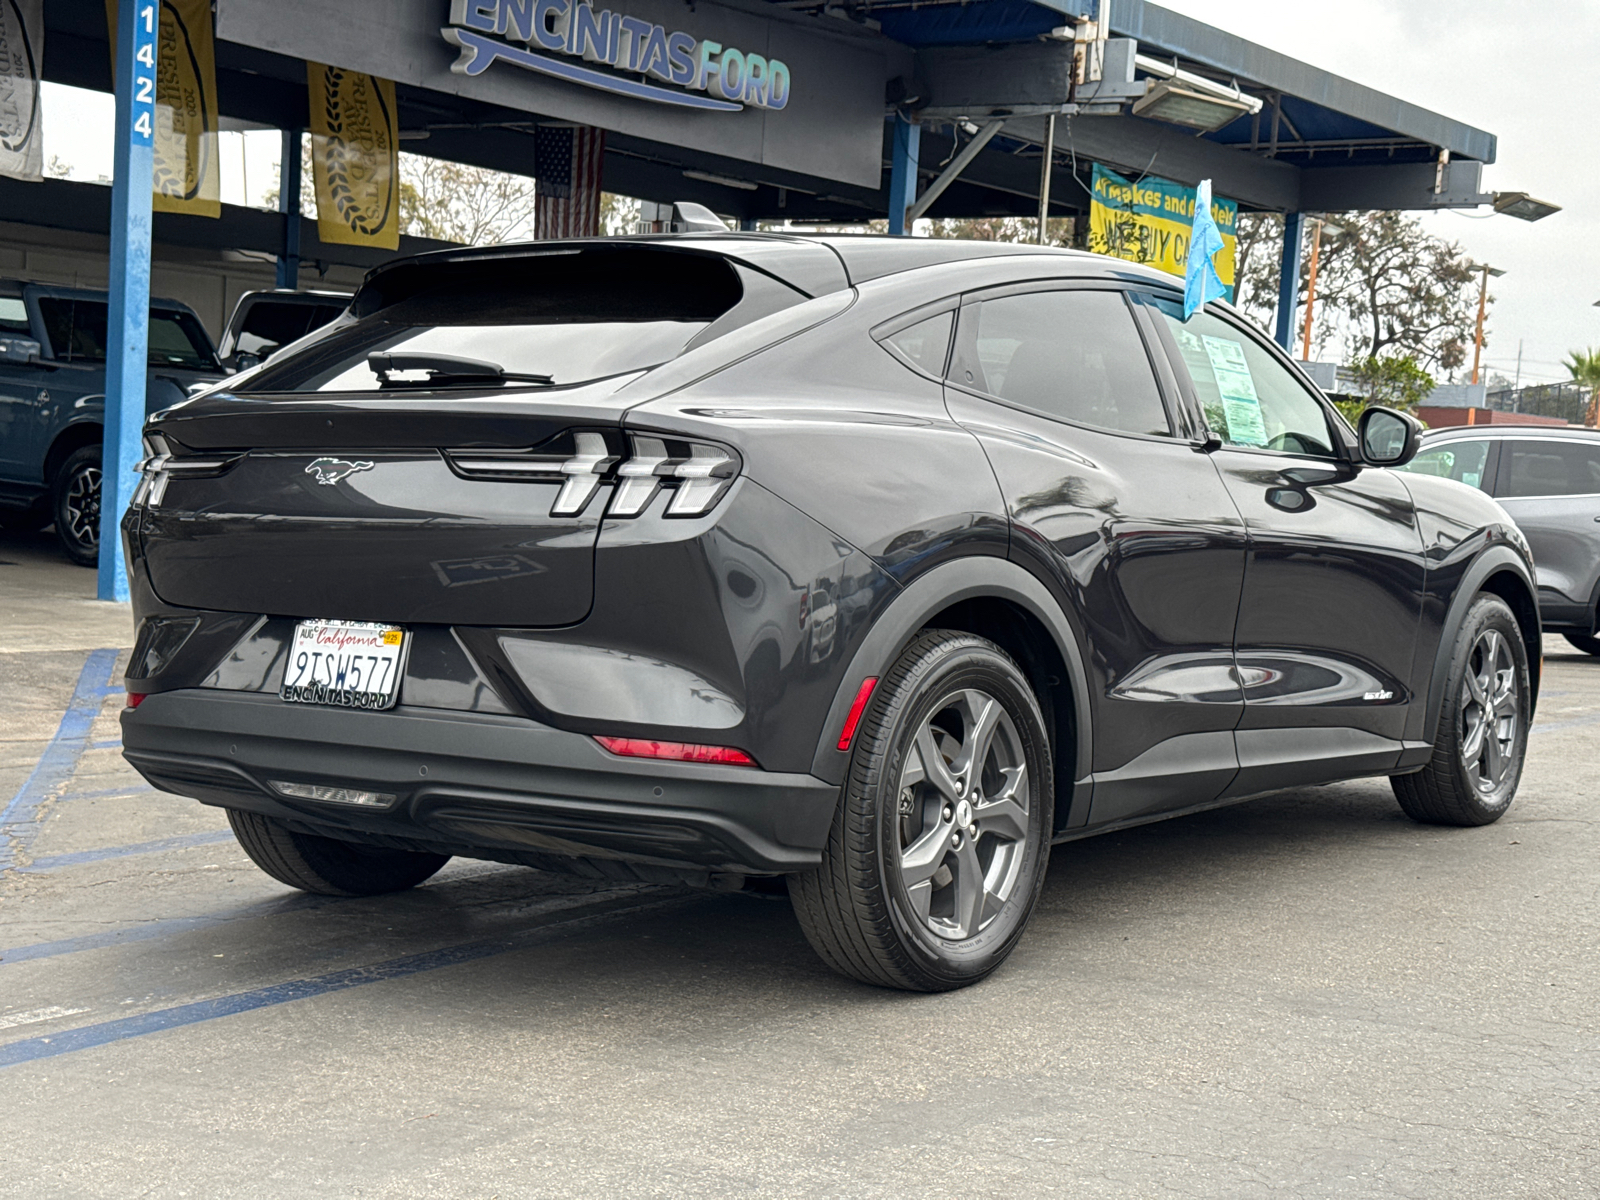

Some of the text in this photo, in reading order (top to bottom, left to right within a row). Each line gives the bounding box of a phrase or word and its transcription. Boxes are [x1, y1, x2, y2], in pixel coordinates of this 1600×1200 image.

[13, 53, 25, 78] 2019
[450, 0, 791, 110] ENCINITAS FORD
[134, 5, 155, 139] 1424
[183, 88, 197, 118] 2020
[375, 130, 387, 155] 2021
[1164, 194, 1187, 217] and
[1137, 224, 1172, 263] BUY
[300, 628, 314, 640] AUG
[316, 627, 384, 651] California
[292, 651, 392, 693] 9TSW577
[283, 685, 386, 709] ENCINITAS FORD
